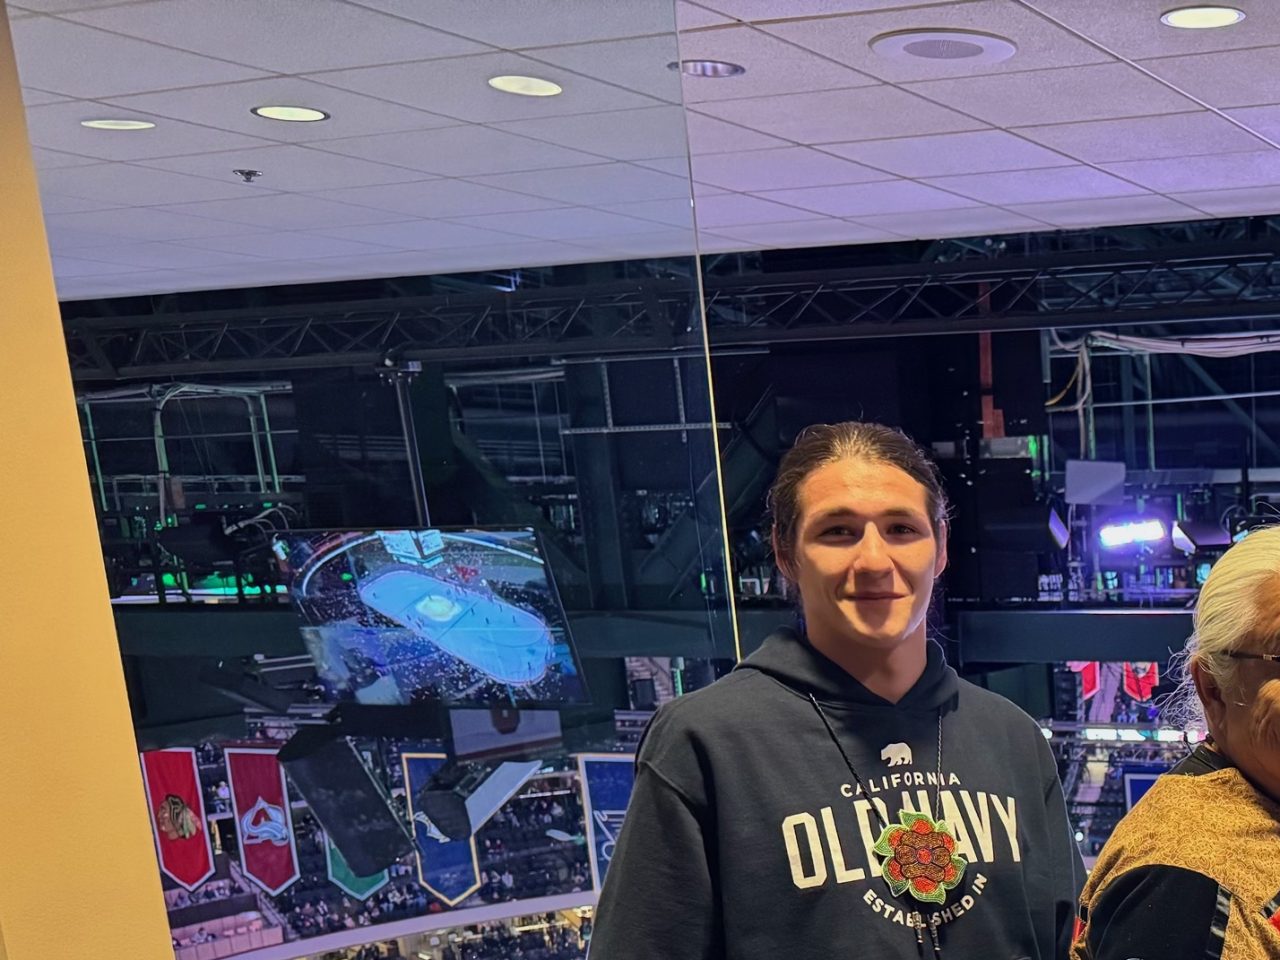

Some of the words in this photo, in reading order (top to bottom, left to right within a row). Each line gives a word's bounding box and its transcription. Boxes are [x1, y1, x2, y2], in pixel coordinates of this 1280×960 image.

[840, 771, 961, 798] CALIFORNIA
[862, 888, 975, 929] ESTABLSHED
[973, 872, 988, 897] IN
